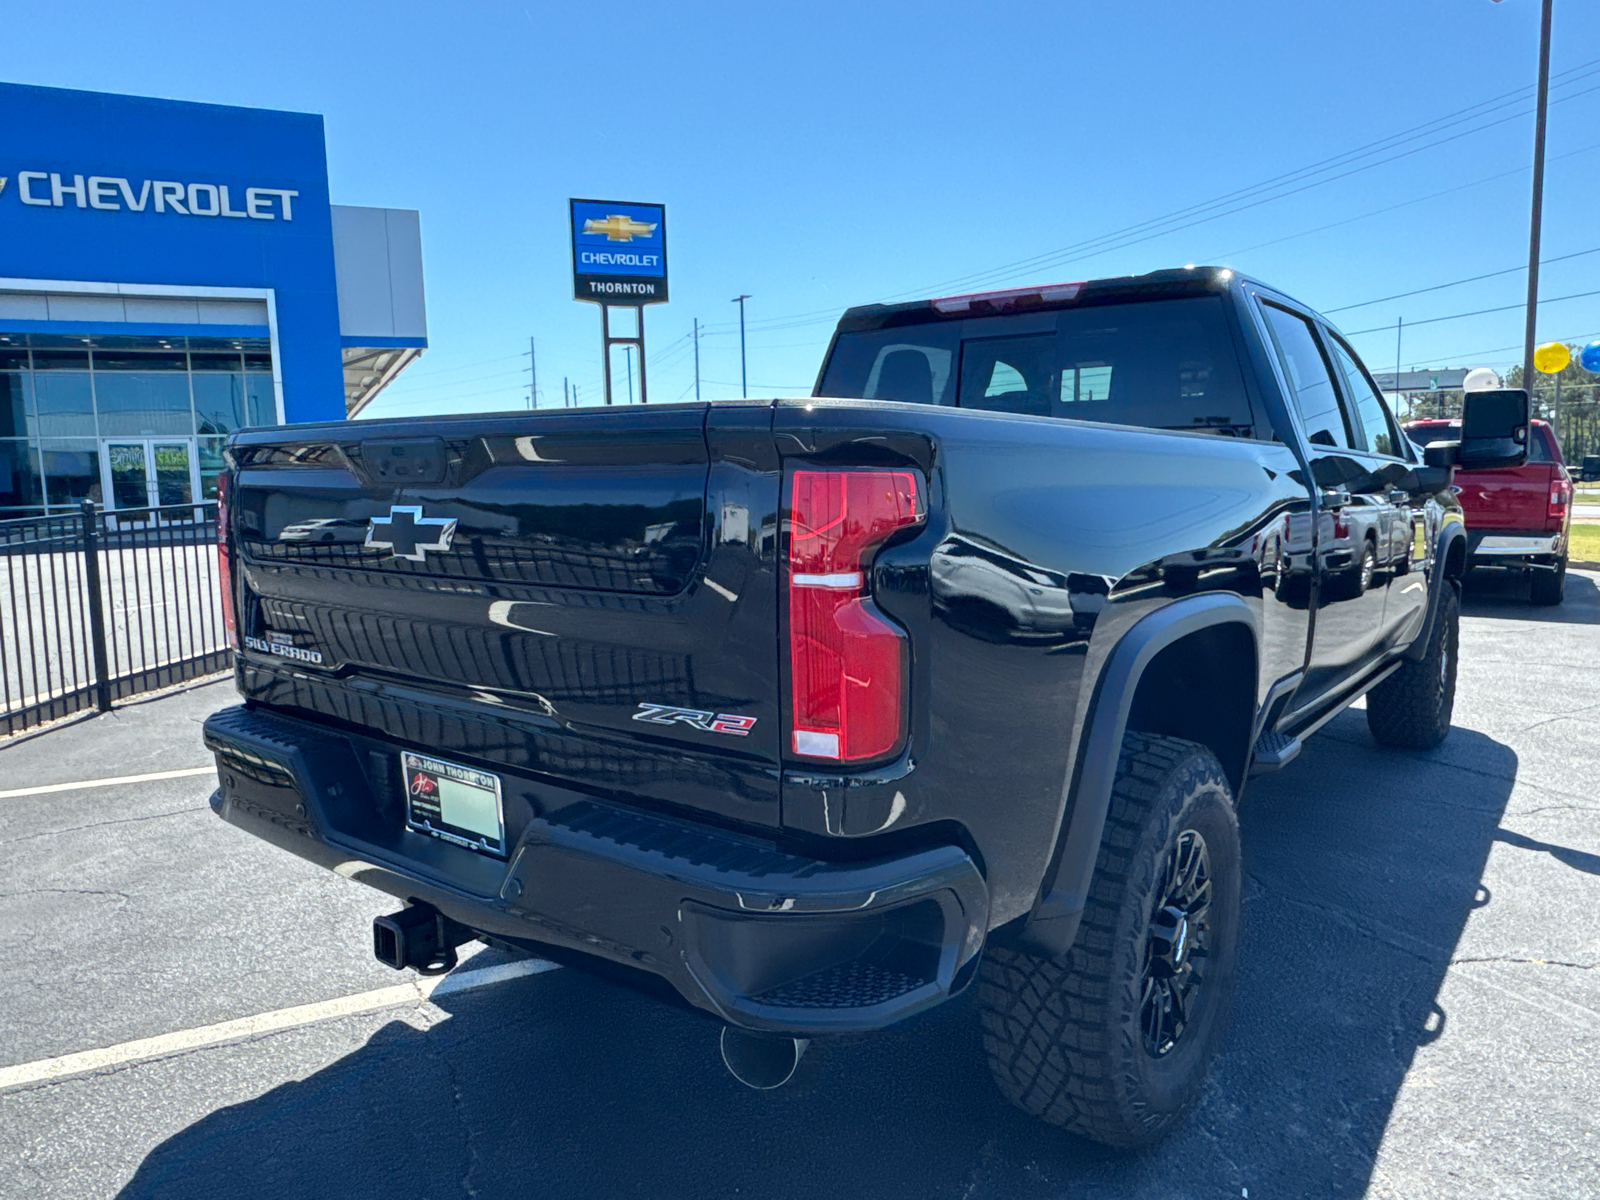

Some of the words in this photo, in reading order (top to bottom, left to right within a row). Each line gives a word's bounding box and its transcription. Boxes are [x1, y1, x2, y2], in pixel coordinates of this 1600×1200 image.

[18, 170, 299, 221] CHEVROLET
[581, 252, 659, 266] CHEVROLET
[589, 282, 655, 294] THORNTON
[245, 636, 322, 664] SILVERADO
[632, 702, 757, 736] ZR2
[423, 760, 445, 774] JOHN
